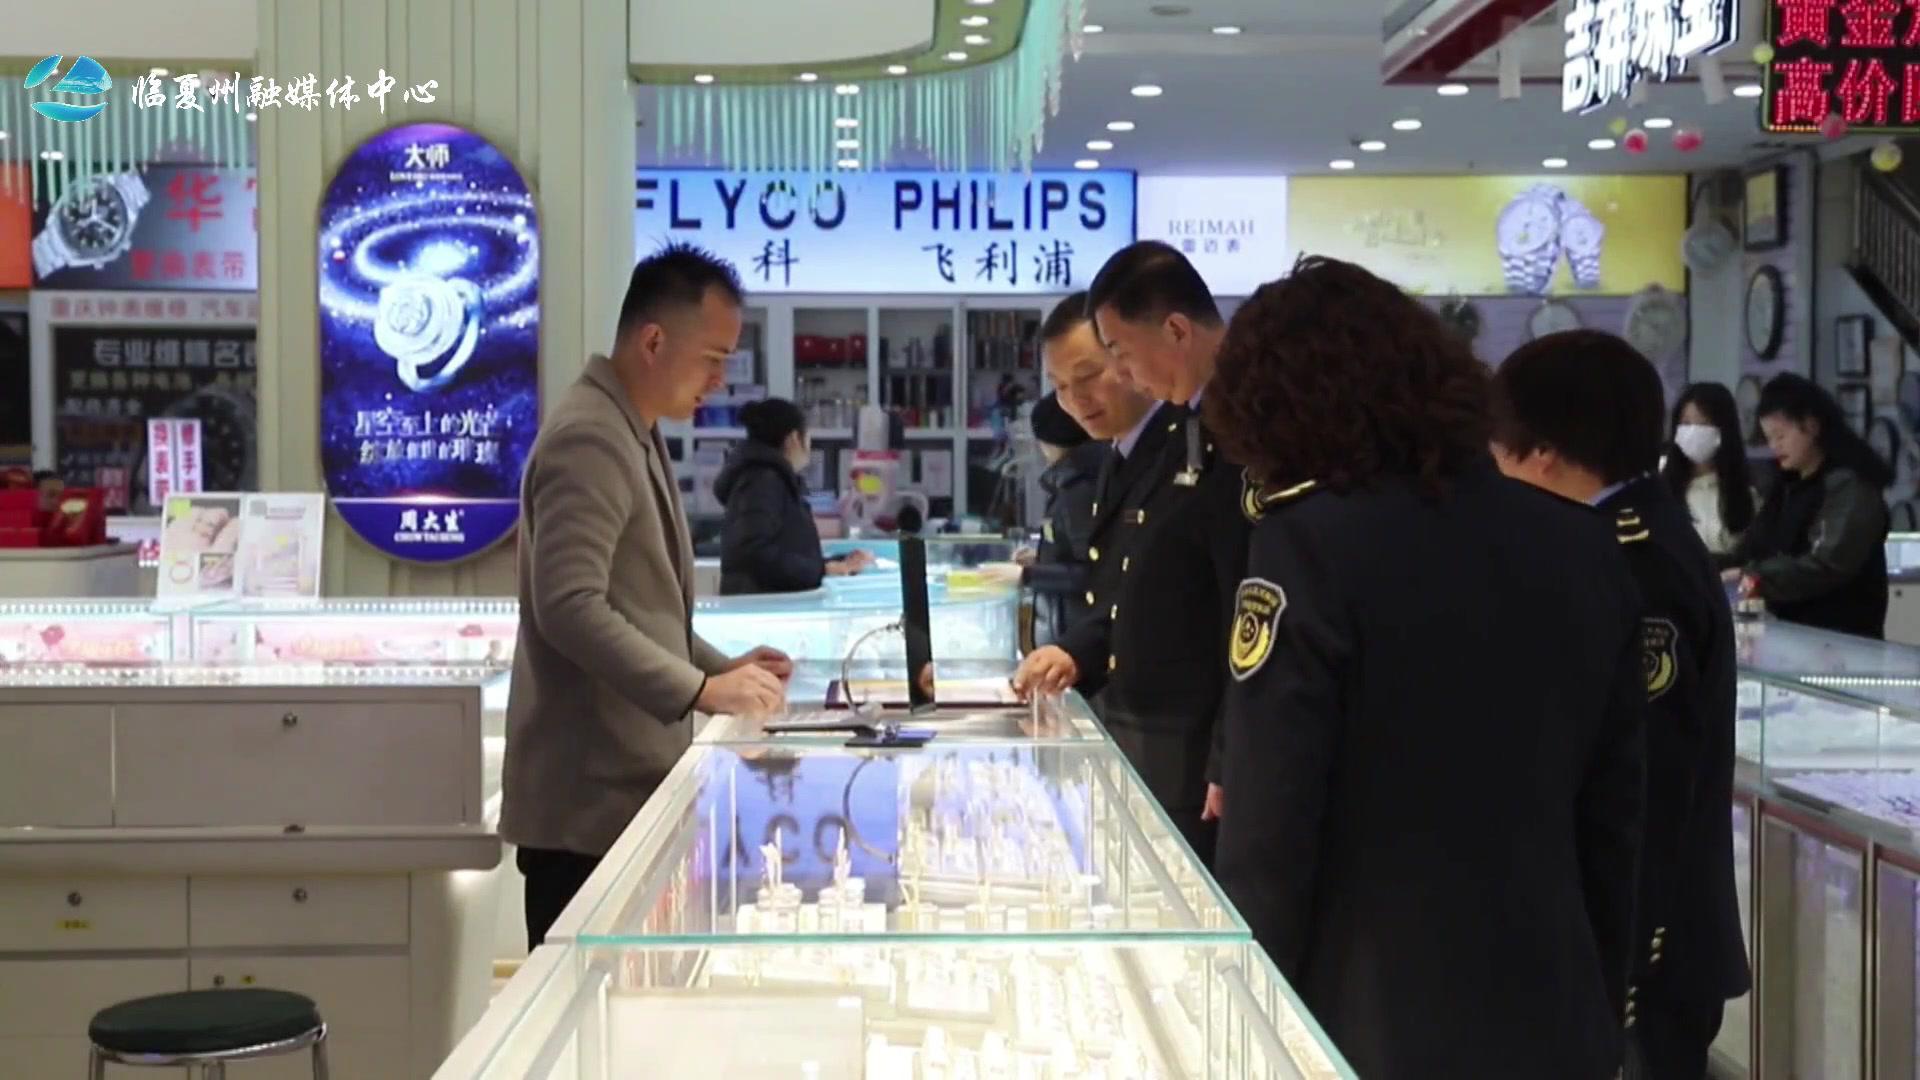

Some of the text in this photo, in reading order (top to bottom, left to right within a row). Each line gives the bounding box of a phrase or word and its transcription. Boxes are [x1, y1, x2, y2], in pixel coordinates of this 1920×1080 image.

[404, 143, 450, 169] 大师
[165, 170, 257, 233] 华
[894, 179, 1107, 231] PHILIPS
[1168, 219, 1254, 235] REIMAH
[921, 239, 1075, 288] 飞利浦
[400, 509, 459, 531] 周大生
